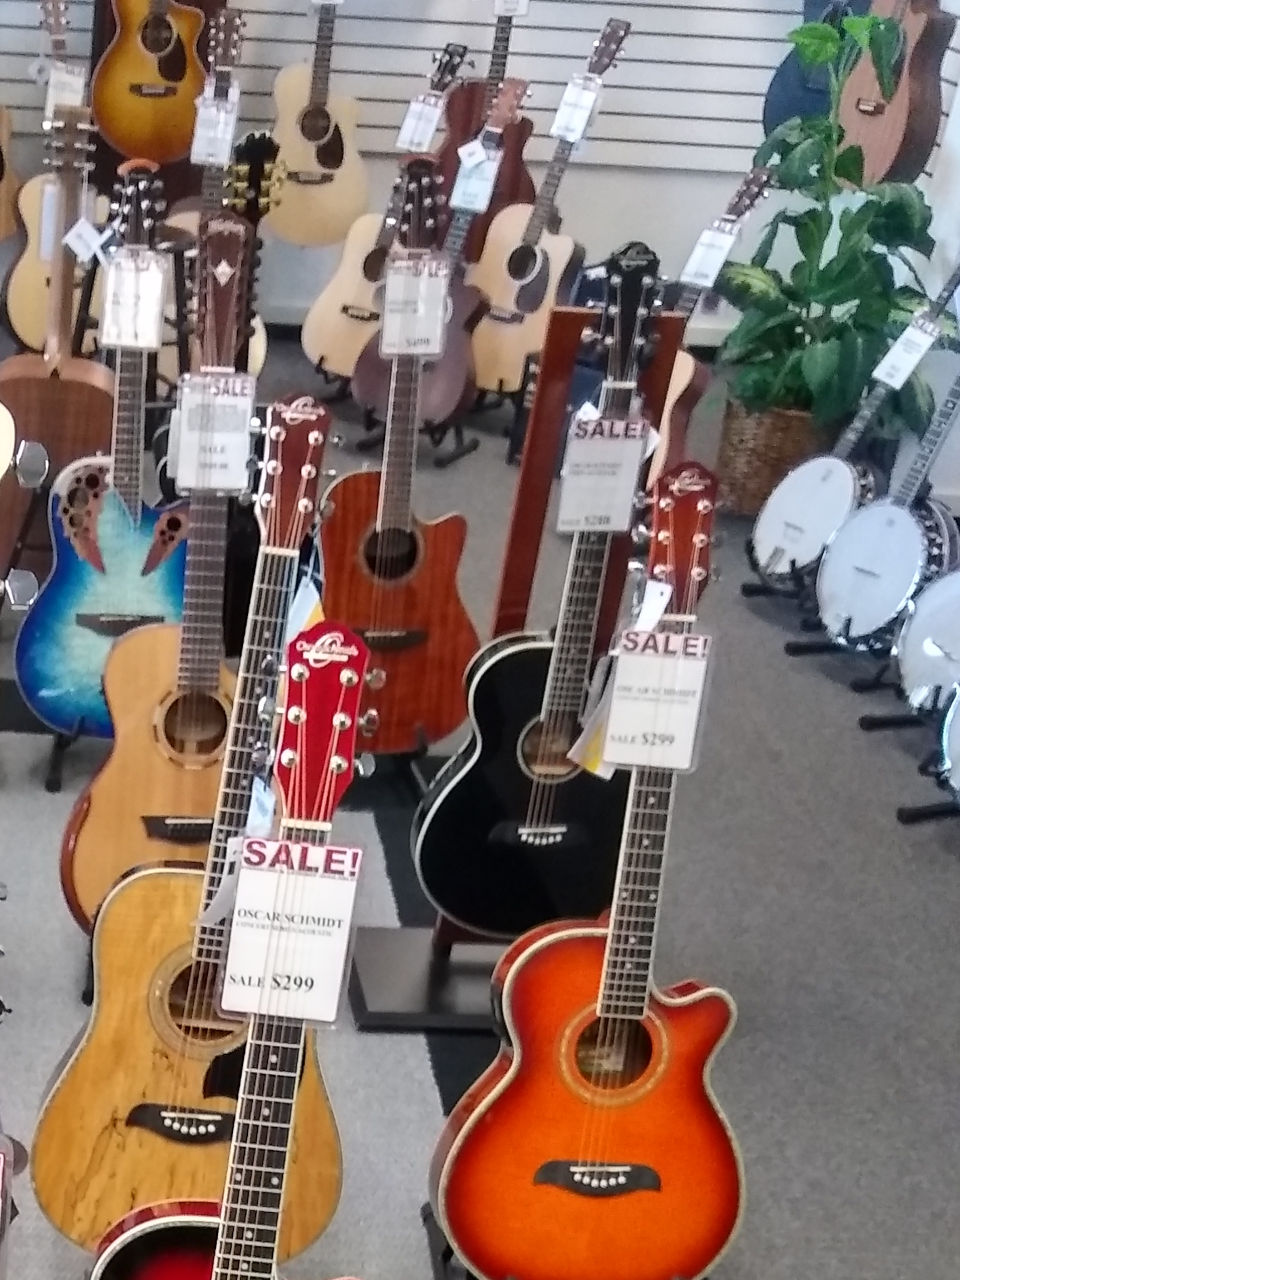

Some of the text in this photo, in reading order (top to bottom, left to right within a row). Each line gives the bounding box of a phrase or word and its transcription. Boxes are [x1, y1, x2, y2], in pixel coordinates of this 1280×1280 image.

[575, 421, 646, 439] SALE!
[623, 632, 708, 657] SALE!
[243, 840, 360, 877] SALE!
[237, 907, 345, 930] OSCAR SCHMIDT
[229, 973, 316, 993] SALE $299
